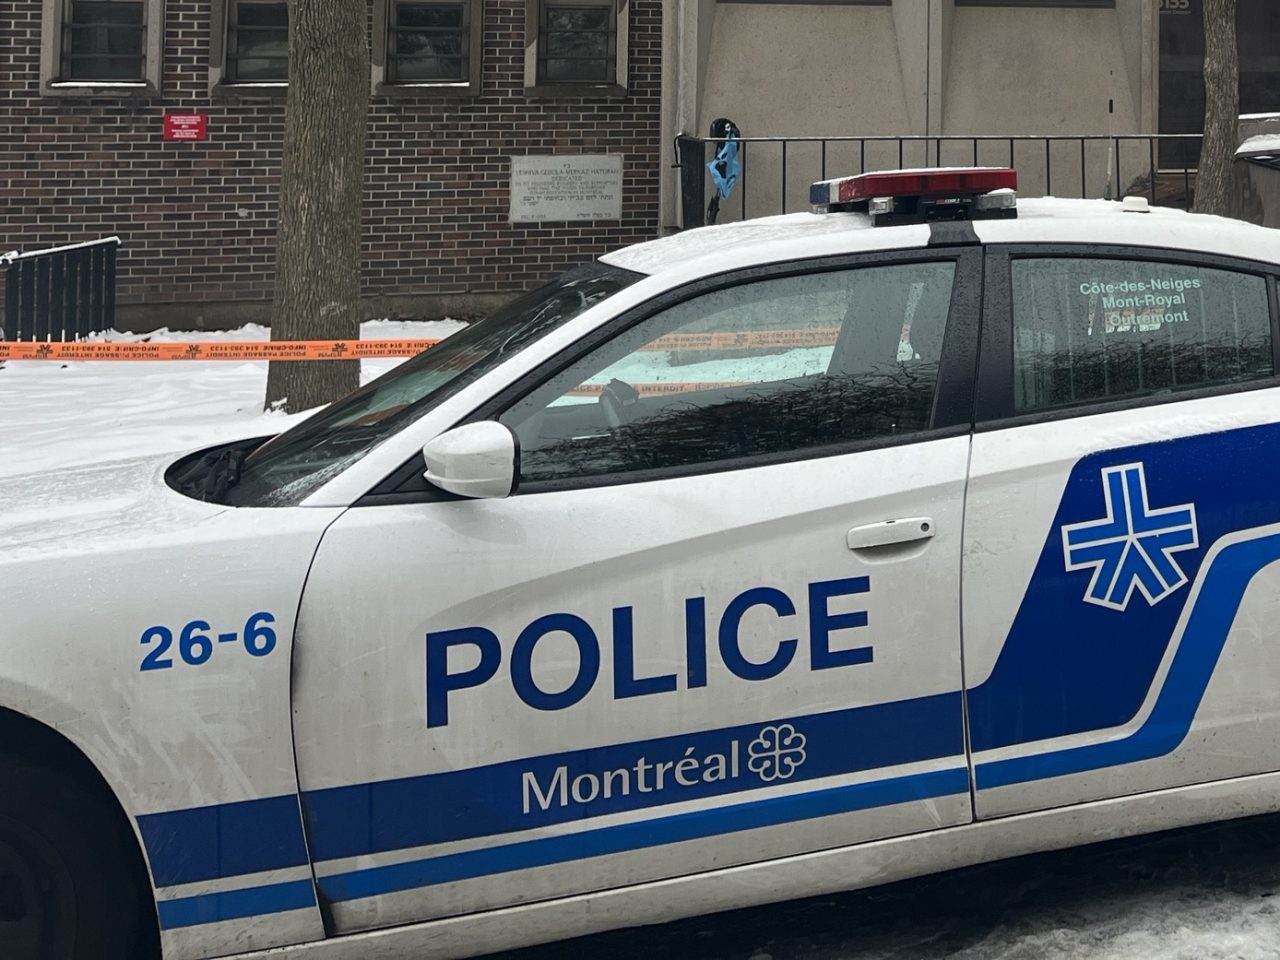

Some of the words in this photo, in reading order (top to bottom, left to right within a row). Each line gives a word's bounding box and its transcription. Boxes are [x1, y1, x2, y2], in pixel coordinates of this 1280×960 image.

[1079, 277, 1201, 295] Côte-des-Neiges
[1102, 293, 1186, 309] Mont-Royal
[1109, 310, 1189, 326] Outremont
[139, 611, 277, 671] 26-6
[426, 576, 875, 729] POLICE
[523, 741, 740, 814] Montréal
